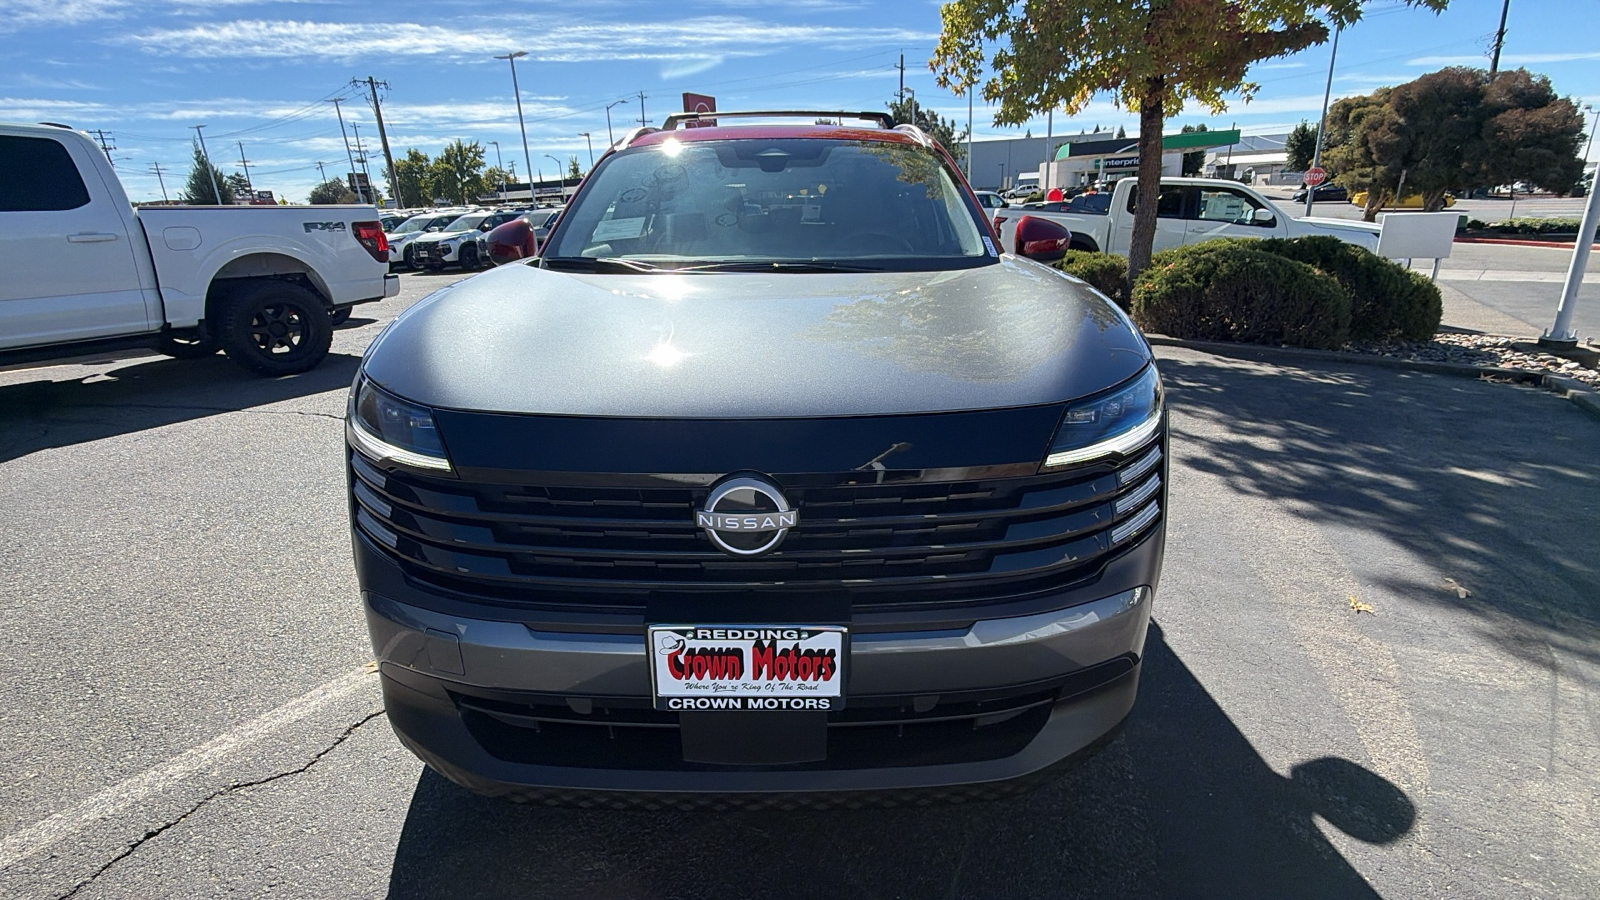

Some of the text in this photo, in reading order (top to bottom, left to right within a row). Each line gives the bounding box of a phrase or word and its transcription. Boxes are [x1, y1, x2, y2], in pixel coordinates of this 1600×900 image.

[1305, 172, 1324, 181] STOP
[303, 221, 346, 233] FX4
[699, 514, 794, 529] NISSAN
[697, 629, 799, 640] REDDING
[667, 642, 835, 682] Crown Motors
[684, 682, 820, 693] Where You're King Of The Road
[668, 698, 831, 710] CROWN MOTORS
